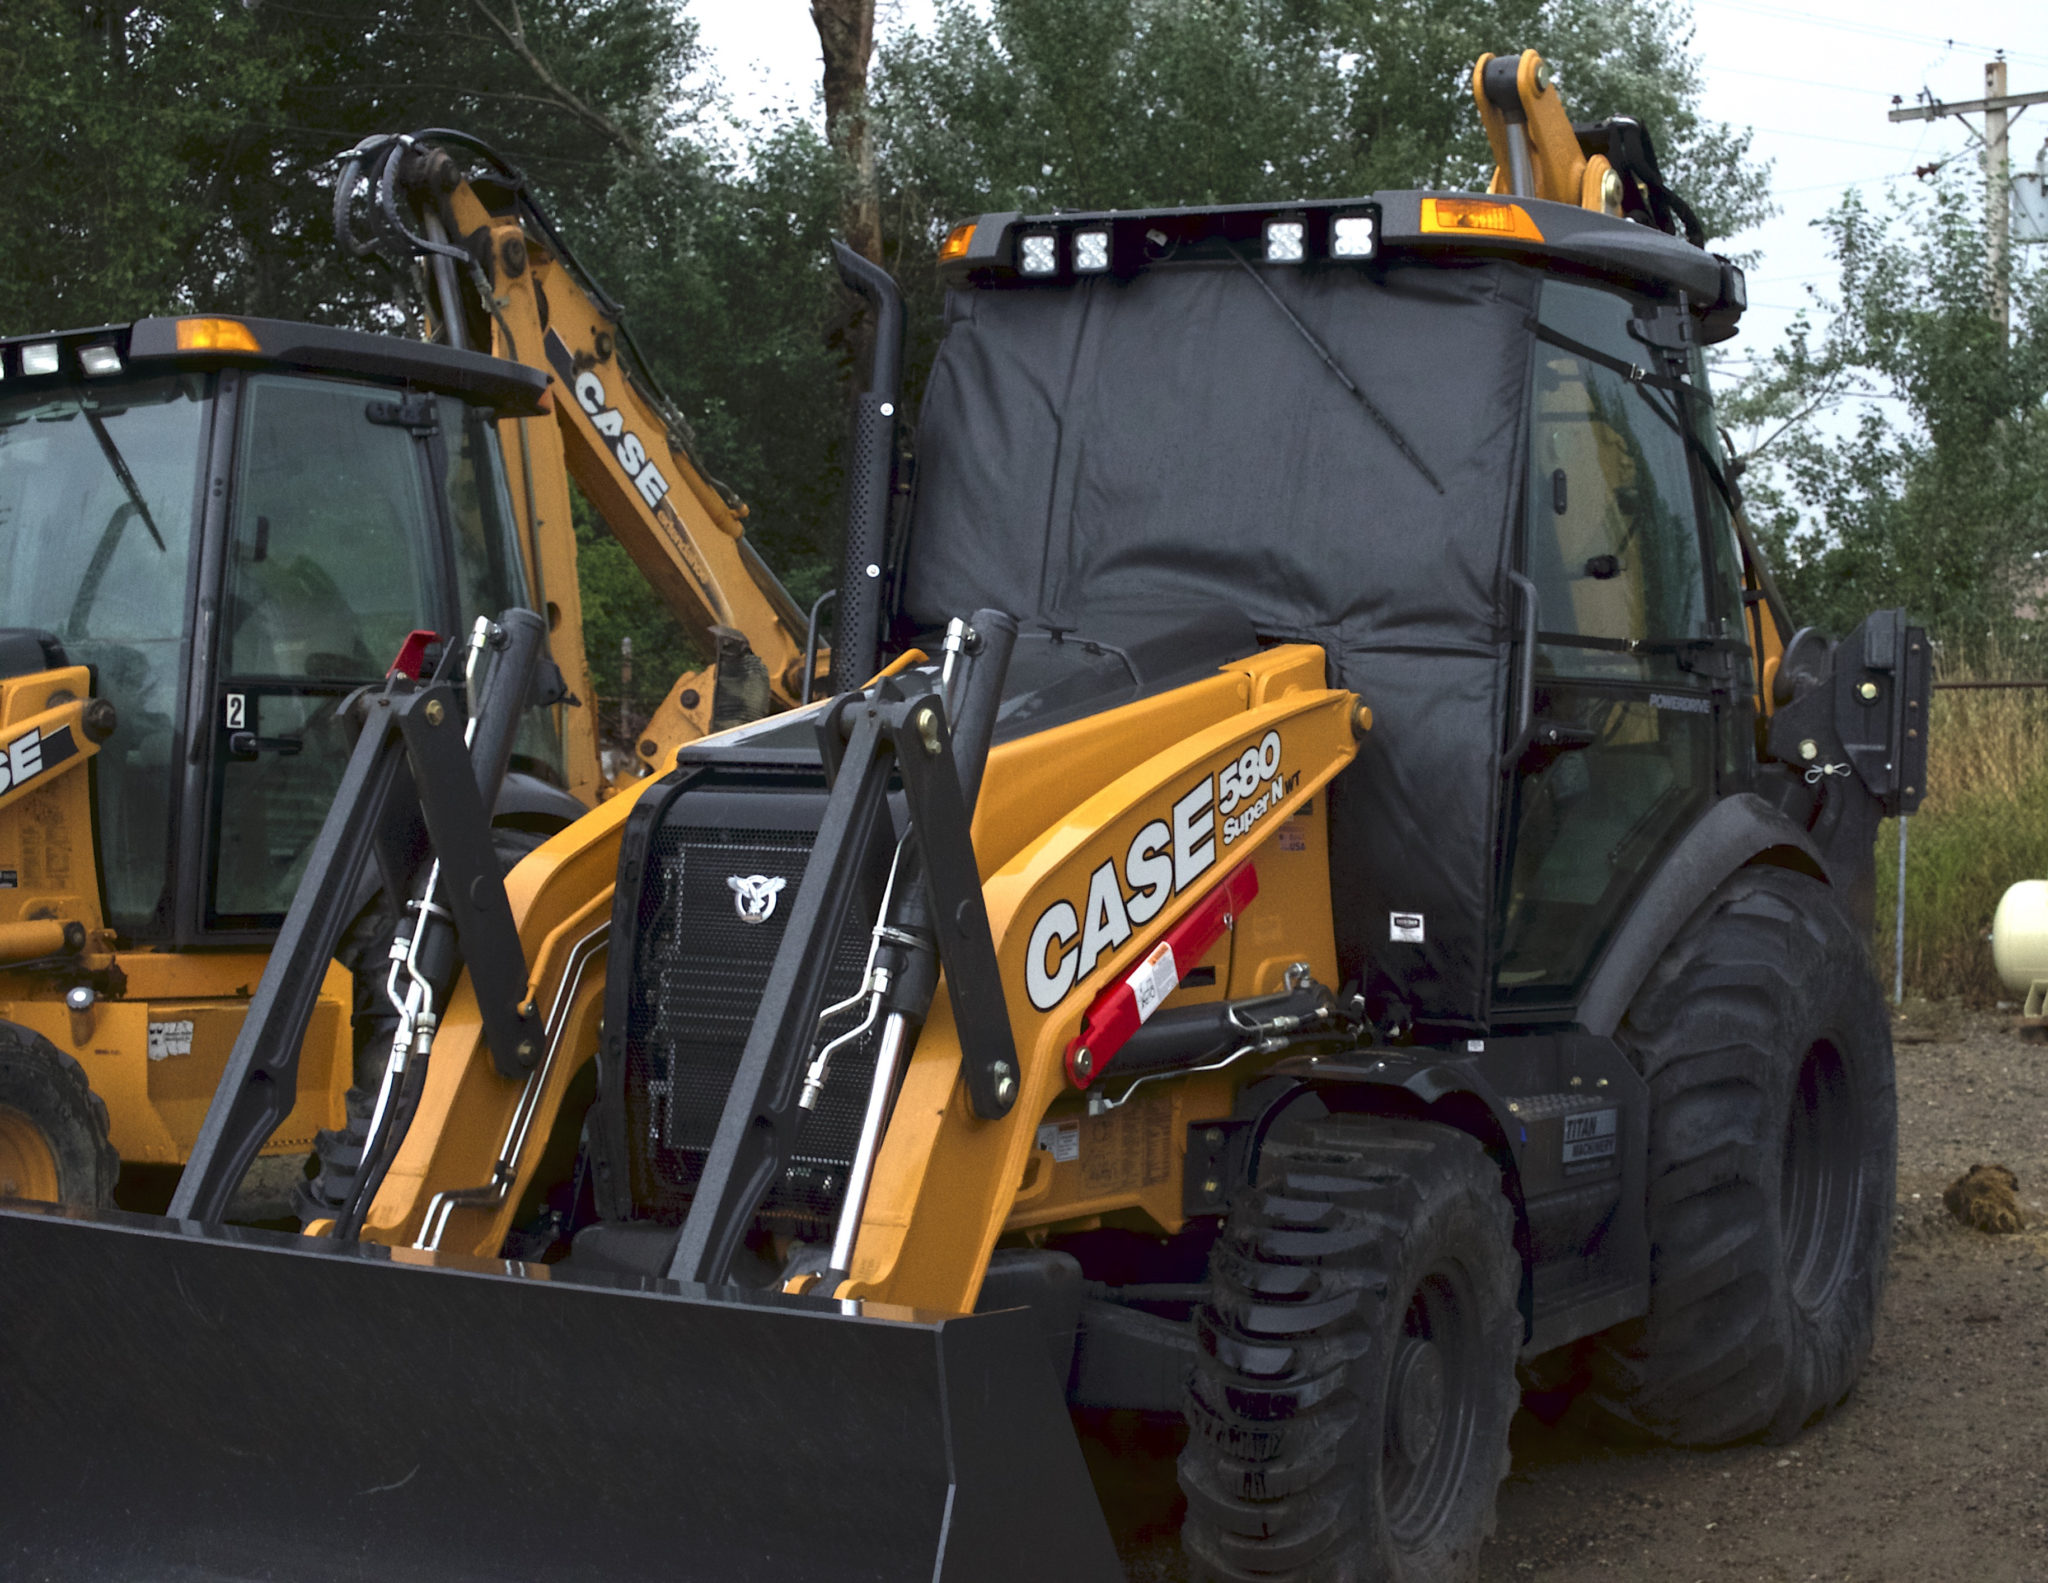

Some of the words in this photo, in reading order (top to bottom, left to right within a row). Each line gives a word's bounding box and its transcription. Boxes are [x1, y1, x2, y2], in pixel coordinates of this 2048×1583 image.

[575, 371, 670, 509] CASE
[230, 696, 243, 726] 2
[1218, 729, 1282, 816] 580
[1223, 792, 1271, 845] Super
[1271, 773, 1284, 807] N
[1285, 769, 1301, 795] WT
[1025, 771, 1217, 1013] CASE
[1567, 1116, 1598, 1140] TITAN
